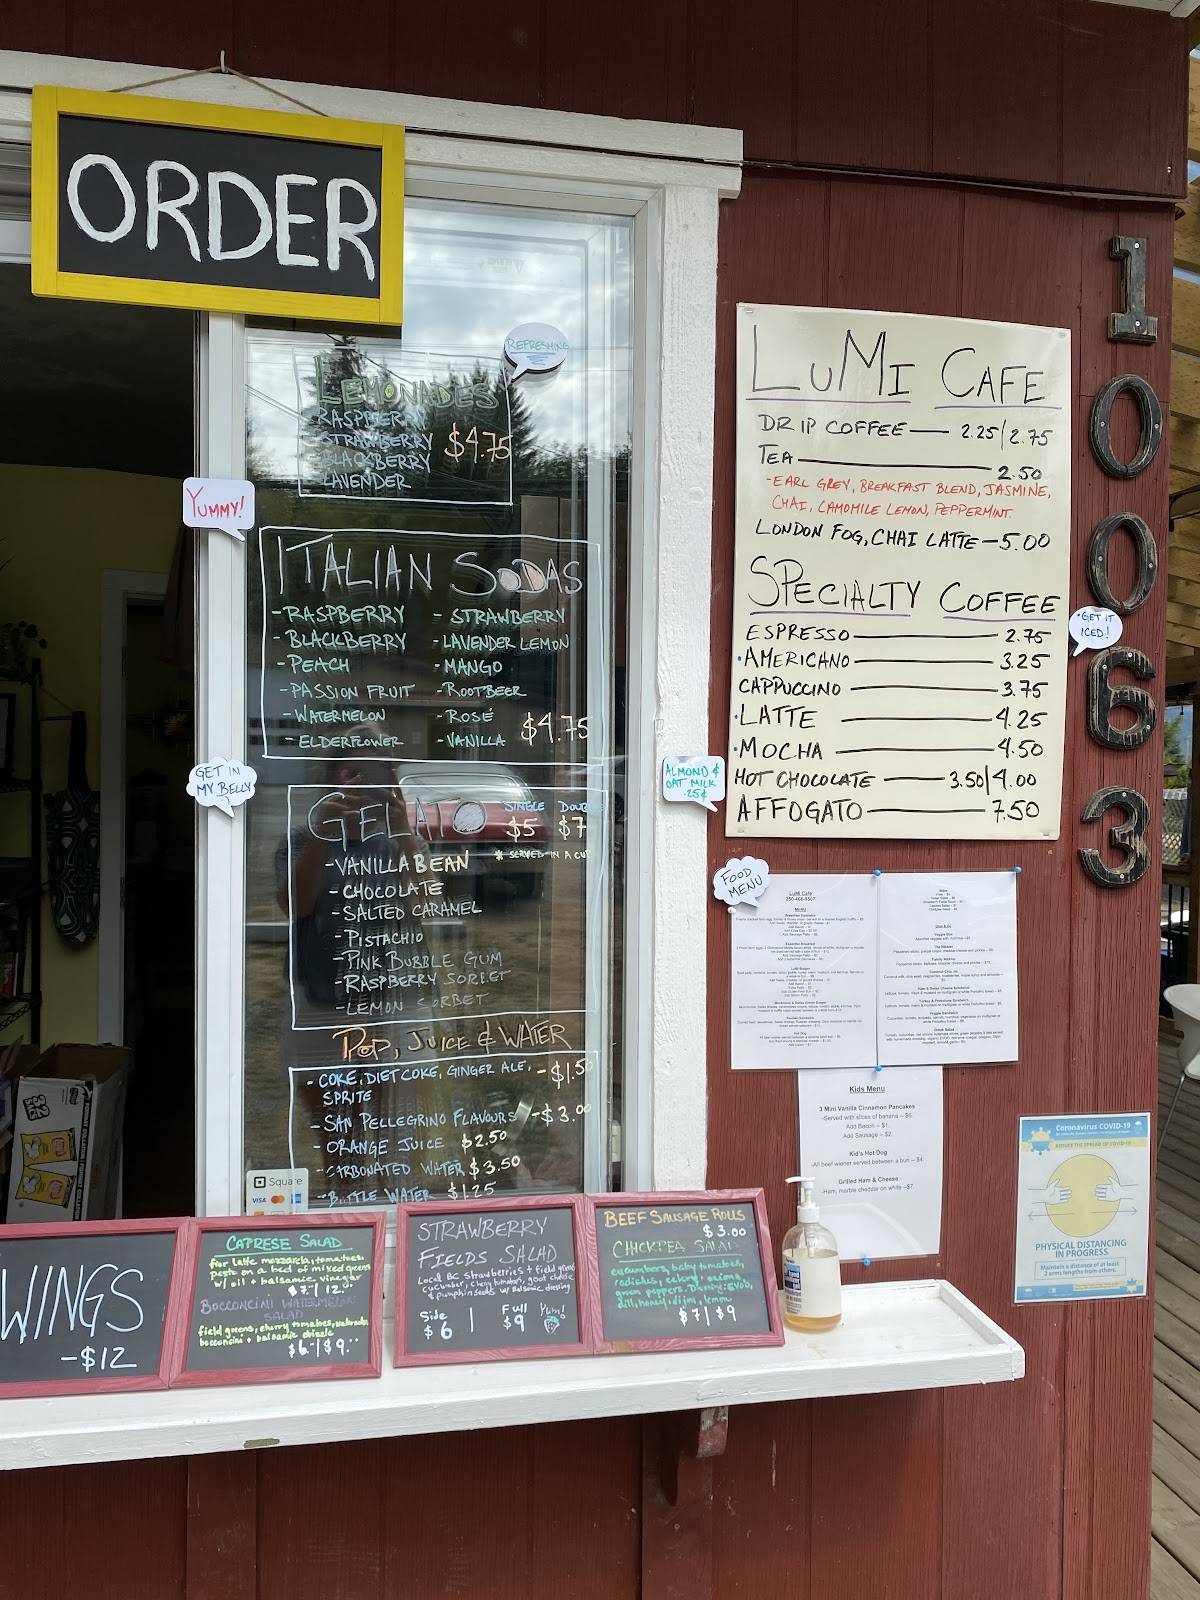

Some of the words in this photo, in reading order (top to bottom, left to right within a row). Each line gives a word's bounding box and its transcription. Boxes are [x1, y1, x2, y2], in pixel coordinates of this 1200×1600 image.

[68, 154, 377, 281] ORDER
[507, 338, 569, 352] REFRESHING
[314, 355, 499, 409] LEMONADES
[941, 348, 1044, 404] CAFE
[758, 415, 816, 434] DRIP
[826, 421, 908, 437] COFFEE
[444, 423, 513, 463] $4.75
[758, 445, 793, 464] TEA
[997, 465, 1042, 480] 2.50
[323, 473, 411, 490] LAVENDER
[817, 479, 856, 494] GREY,
[860, 479, 930, 493] BREAKFAST
[937, 483, 980, 498] BLEND,
[984, 483, 1051, 499] JASMINE,
[186, 486, 244, 518] YUMMY!
[772, 495, 813, 513] CHAI,
[818, 500, 879, 516] CAMOMILE
[886, 503, 929, 518] LEMON,
[755, 519, 823, 537] LONDON
[927, 531, 979, 549] LATTE
[999, 533, 1050, 551] 5.00
[277, 534, 432, 595] ITALIAN
[452, 552, 583, 597] SODAS
[749, 556, 921, 612] SPECIALTY
[940, 581, 1060, 616] COFFEE
[1106, 614, 1115, 622] IT
[520, 635, 570, 650] LEMON
[746, 624, 850, 642] ESPRESSO
[1006, 628, 1052, 645] 2.75
[1081, 626, 1109, 639] ICED!
[744, 648, 850, 670] AMERICANO
[1000, 653, 1050, 671] 3.25
[367, 683, 415, 698] FRUIT
[739, 677, 841, 697] CAPPUCCINO
[1001, 681, 1048, 699] 3.75
[521, 711, 592, 745] $4.75
[740, 705, 817, 729] LATTE
[996, 706, 1048, 729] 4.25
[740, 740, 822, 760] MOCHA
[997, 737, 1043, 758] 4.50
[195, 765, 223, 781] GET
[229, 767, 240, 776] IN
[665, 763, 709, 777] ALMOND
[735, 769, 774, 787] HOT
[776, 772, 876, 789] CHOCOLATE
[197, 783, 213, 796] MY
[216, 782, 251, 797] BELLY
[666, 778, 688, 788] OAT
[691, 779, 717, 789] MILK
[308, 792, 488, 852] GELATO
[504, 801, 545, 813] SINGLE
[737, 799, 862, 823] AFFOGATO
[992, 800, 1040, 823] 7.50
[506, 815, 538, 842] $5
[559, 814, 587, 841] $7
[413, 849, 469, 874] BEAN
[509, 850, 545, 860] SERVED
[550, 851, 559, 859] IN
[565, 851, 572, 859] A
[720, 868, 752, 886] FOOD
[728, 875, 763, 899] MENU
[412, 900, 482, 917] CARAMEL
[386, 950, 455, 971] BUBBLE
[464, 951, 502, 967] GUM
[407, 1026, 471, 1052] JUICE
[499, 1020, 573, 1050] WATER
[365, 1068, 401, 1085] DIET
[447, 1061, 494, 1077] GINGER
[323, 1089, 372, 1106] SPRITE
[866, 1085, 886, 1093] Menu
[324, 1115, 353, 1133] SAN
[360, 1111, 446, 1132] PELLEGRINO
[453, 1109, 517, 1128] FLAVOURS
[1055, 1123, 1098, 1132] Coronavirus
[1099, 1121, 1131, 1130] COVID-19
[326, 1138, 388, 1156] ORANGE
[398, 1135, 444, 1152] JUICE
[461, 1128, 507, 1152] $2.50
[419, 1159, 466, 1178] WATER
[468, 1154, 521, 1179] $3.50
[386, 1186, 435, 1203] WATER
[447, 1181, 498, 1201] $1.25
[418, 1217, 548, 1241] STRAWBERRY
[604, 1211, 647, 1228] BEEF
[650, 1210, 710, 1224] SAUSAGE
[711, 1208, 746, 1222] ROLLS
[226, 1235, 292, 1250] CAPRESE
[300, 1234, 342, 1248] SALAD
[1035, 1241, 1076, 1251] PHYSICAL
[1077, 1239, 1127, 1250] DISTANCING
[1055, 1250, 1064, 1258] IN
[1065, 1248, 1109, 1257] PROGRESS
[418, 1247, 488, 1269] FIELDS
[499, 1244, 558, 1264] SALAD
[0, 1264, 144, 1344] WINGS
[419, 1309, 448, 1322] Side
[502, 1303, 528, 1314] Full
